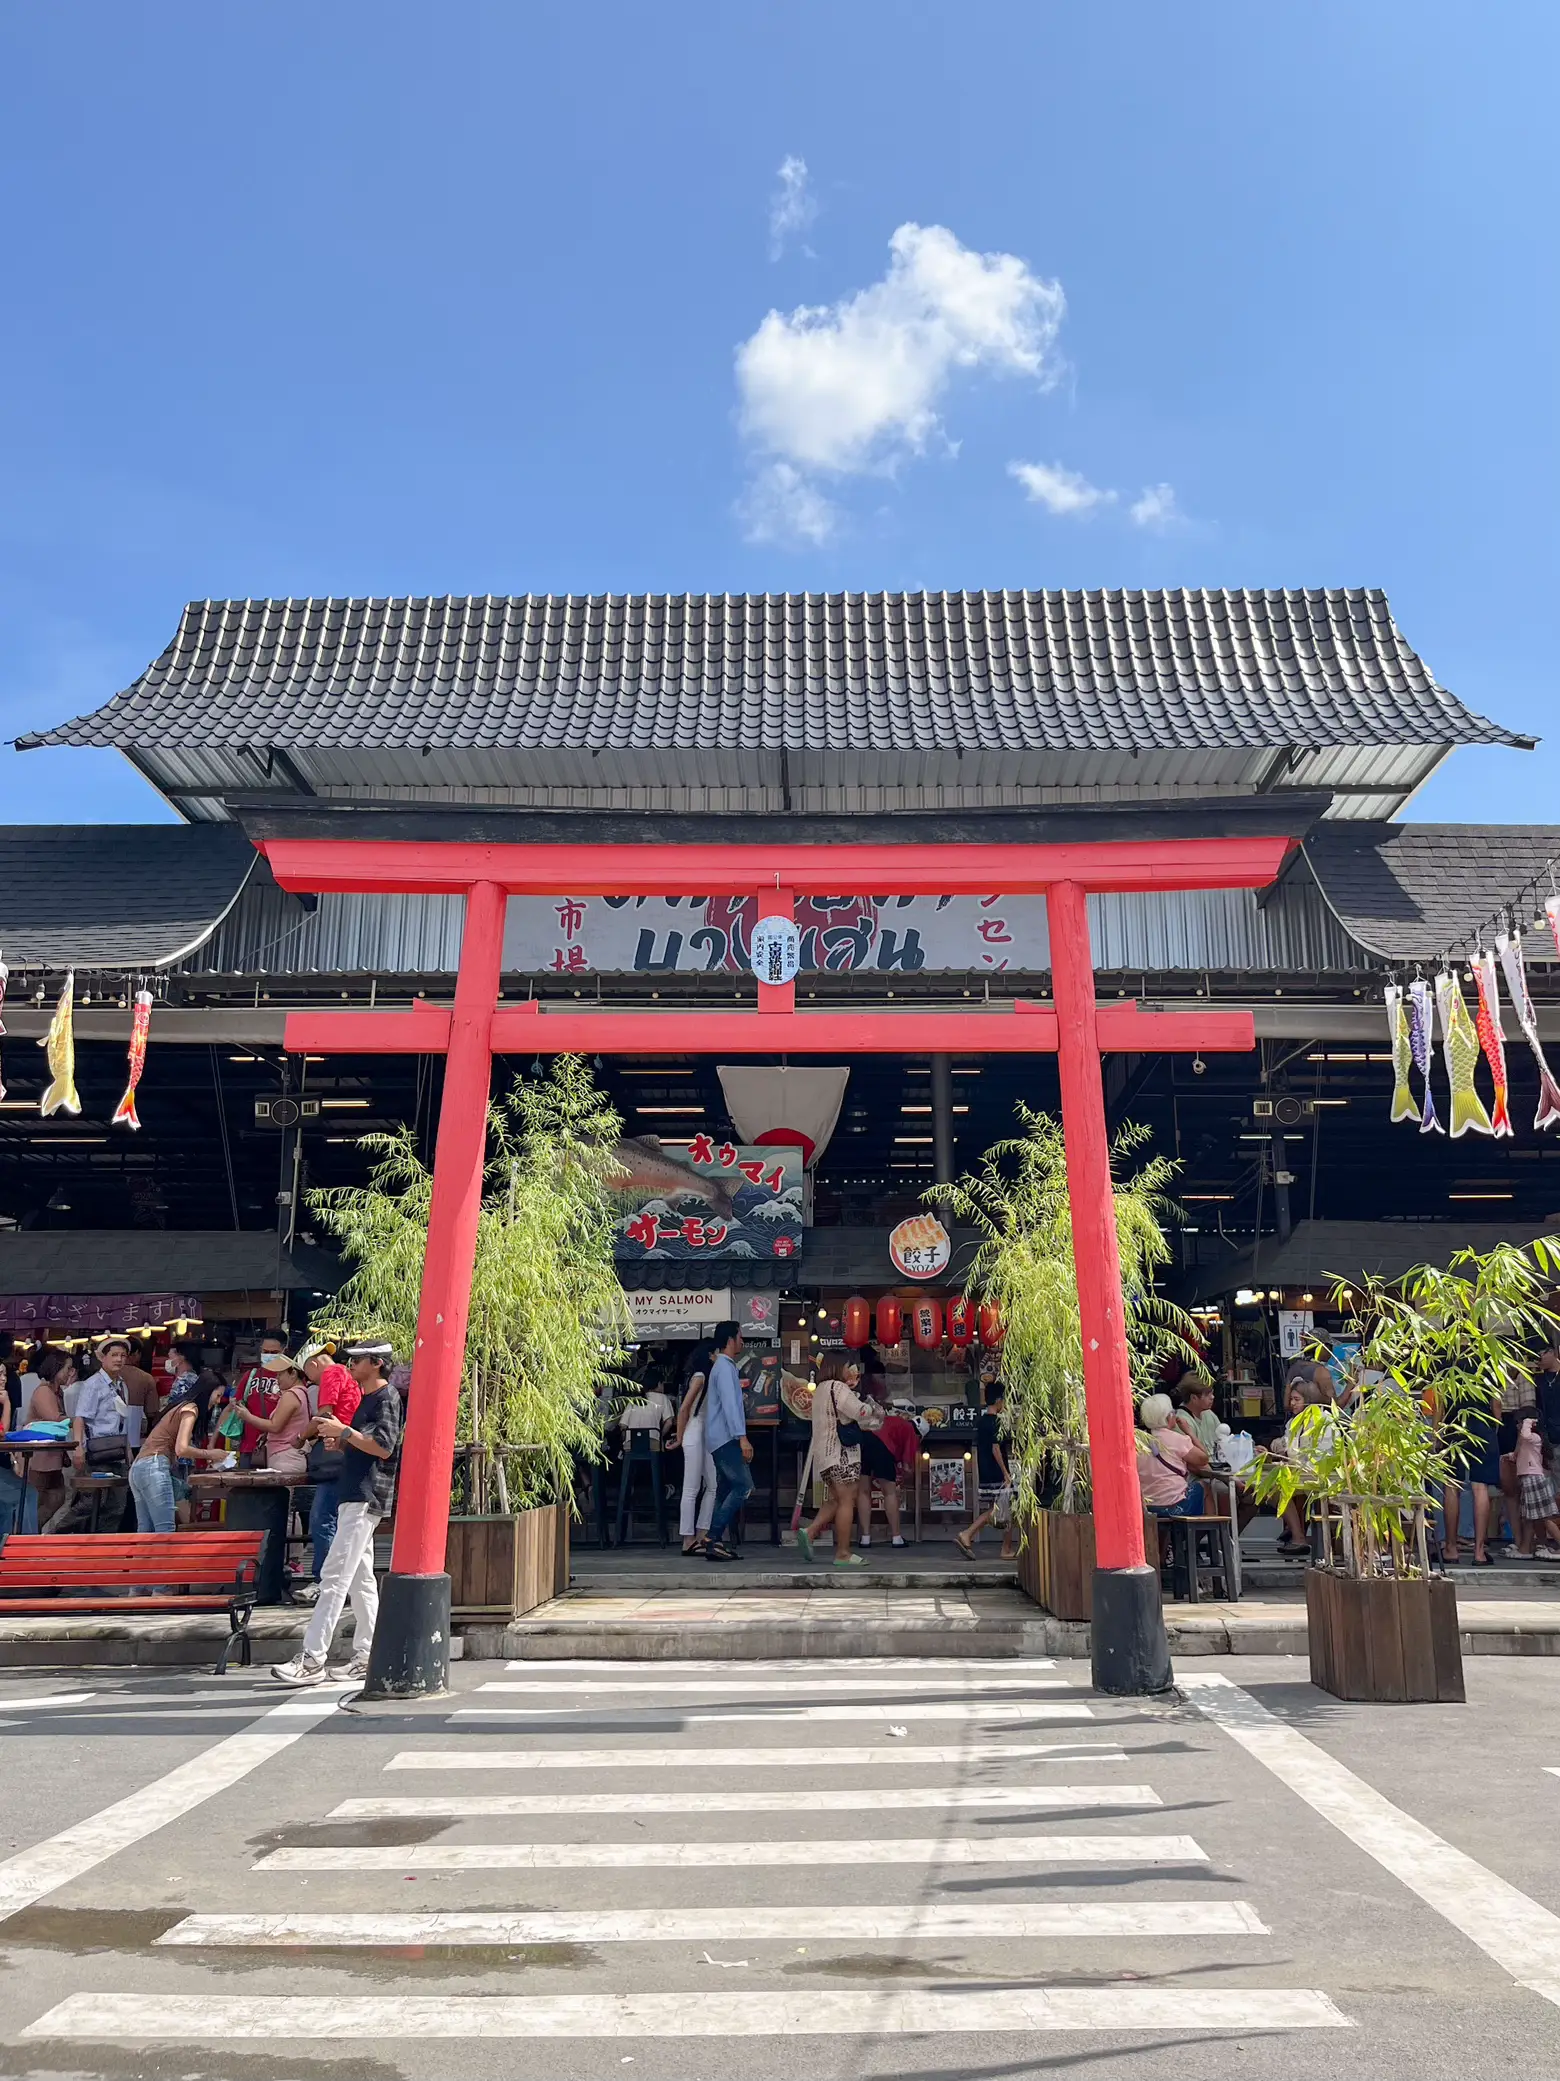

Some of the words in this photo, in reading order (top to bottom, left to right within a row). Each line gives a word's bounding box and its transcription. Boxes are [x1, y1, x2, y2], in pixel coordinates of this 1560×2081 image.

[625, 1212, 727, 1249] サーモン
[903, 1246, 940, 1264] 餃子
[905, 1264, 937, 1273] GYOZA
[635, 1296, 653, 1305] MY
[659, 1295, 713, 1305] SALMON
[953, 1407, 977, 1421] 餃子
